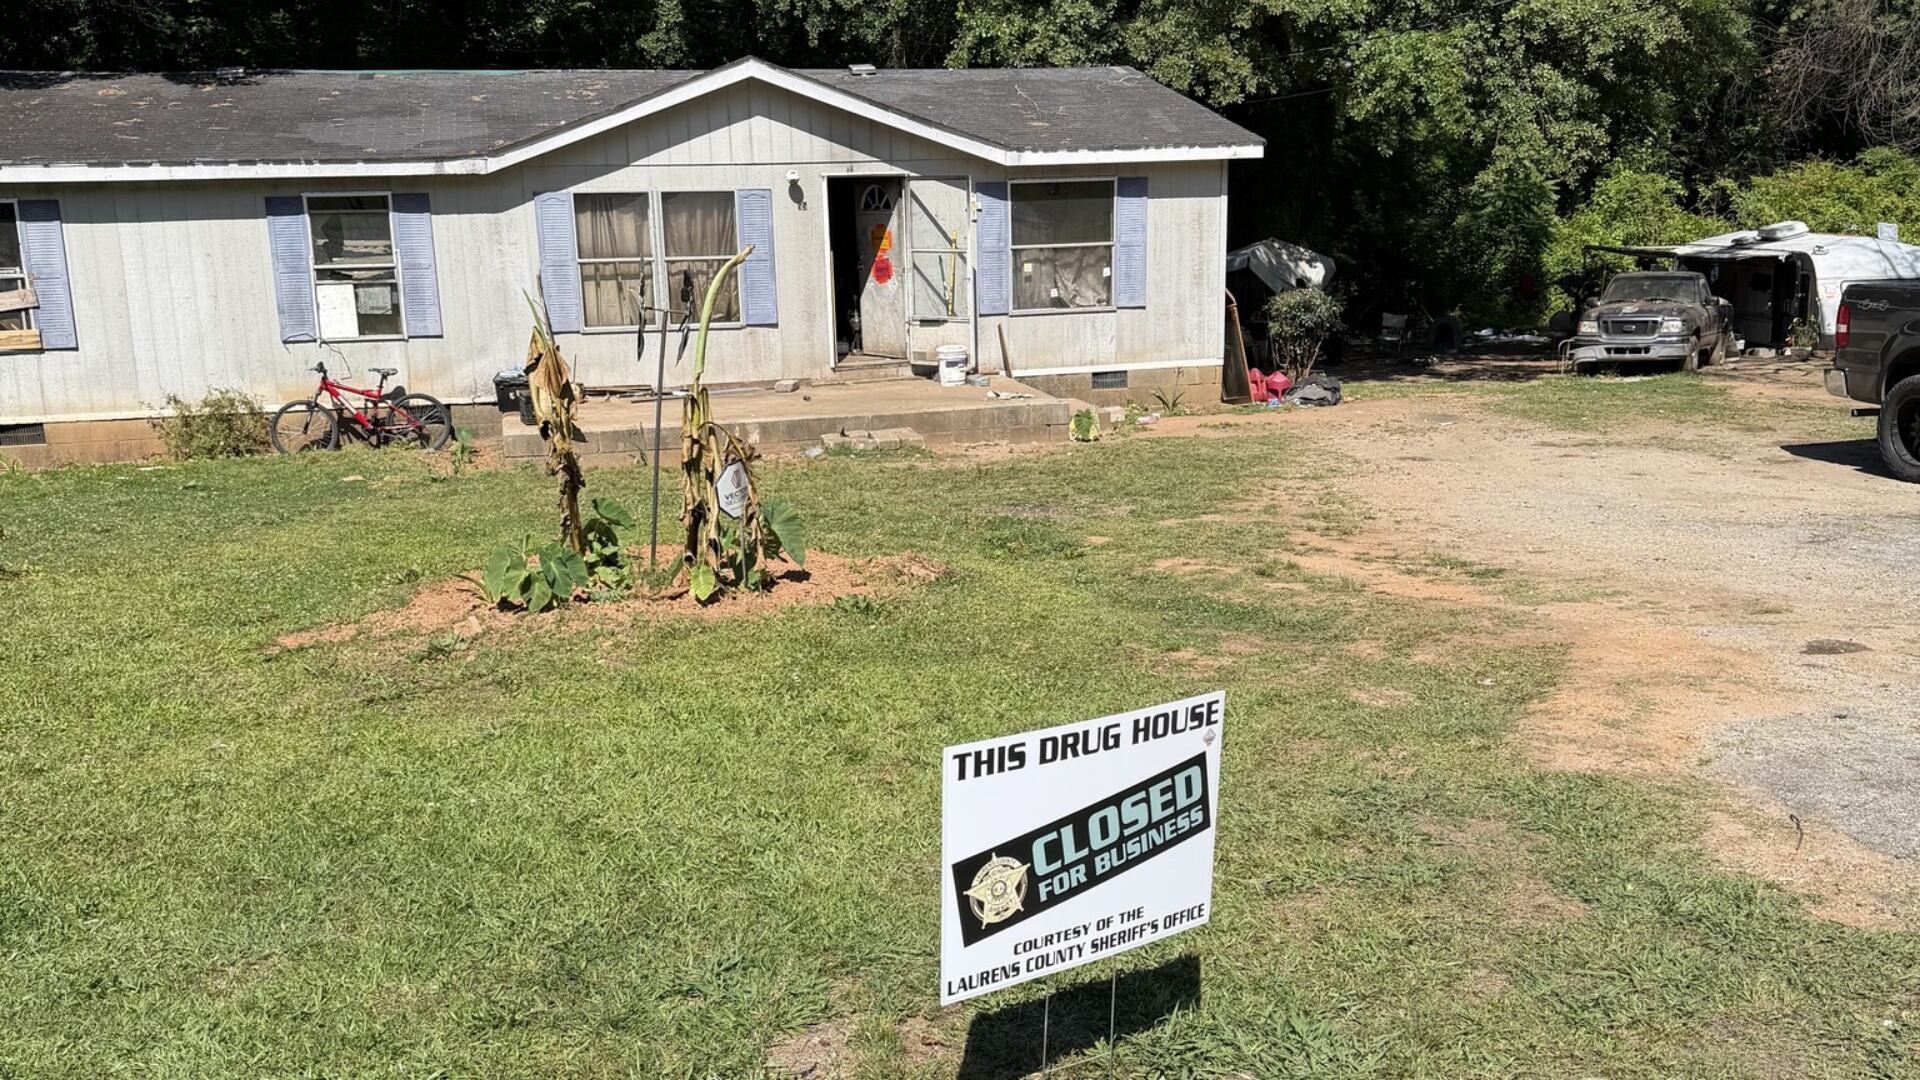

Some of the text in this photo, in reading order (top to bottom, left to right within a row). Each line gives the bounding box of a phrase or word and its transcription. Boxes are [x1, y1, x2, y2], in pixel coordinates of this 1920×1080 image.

[953, 699, 1220, 781] THIS DRUG HOUSE
[1031, 764, 1203, 877] CLOSED
[1038, 863, 1088, 903] FOR
[1094, 804, 1204, 876] BUSINESS
[947, 903, 1206, 998] LAURENS COUNTY SHERIFF'S OFFICE
[1013, 906, 1145, 956] COURTESY OF THE
